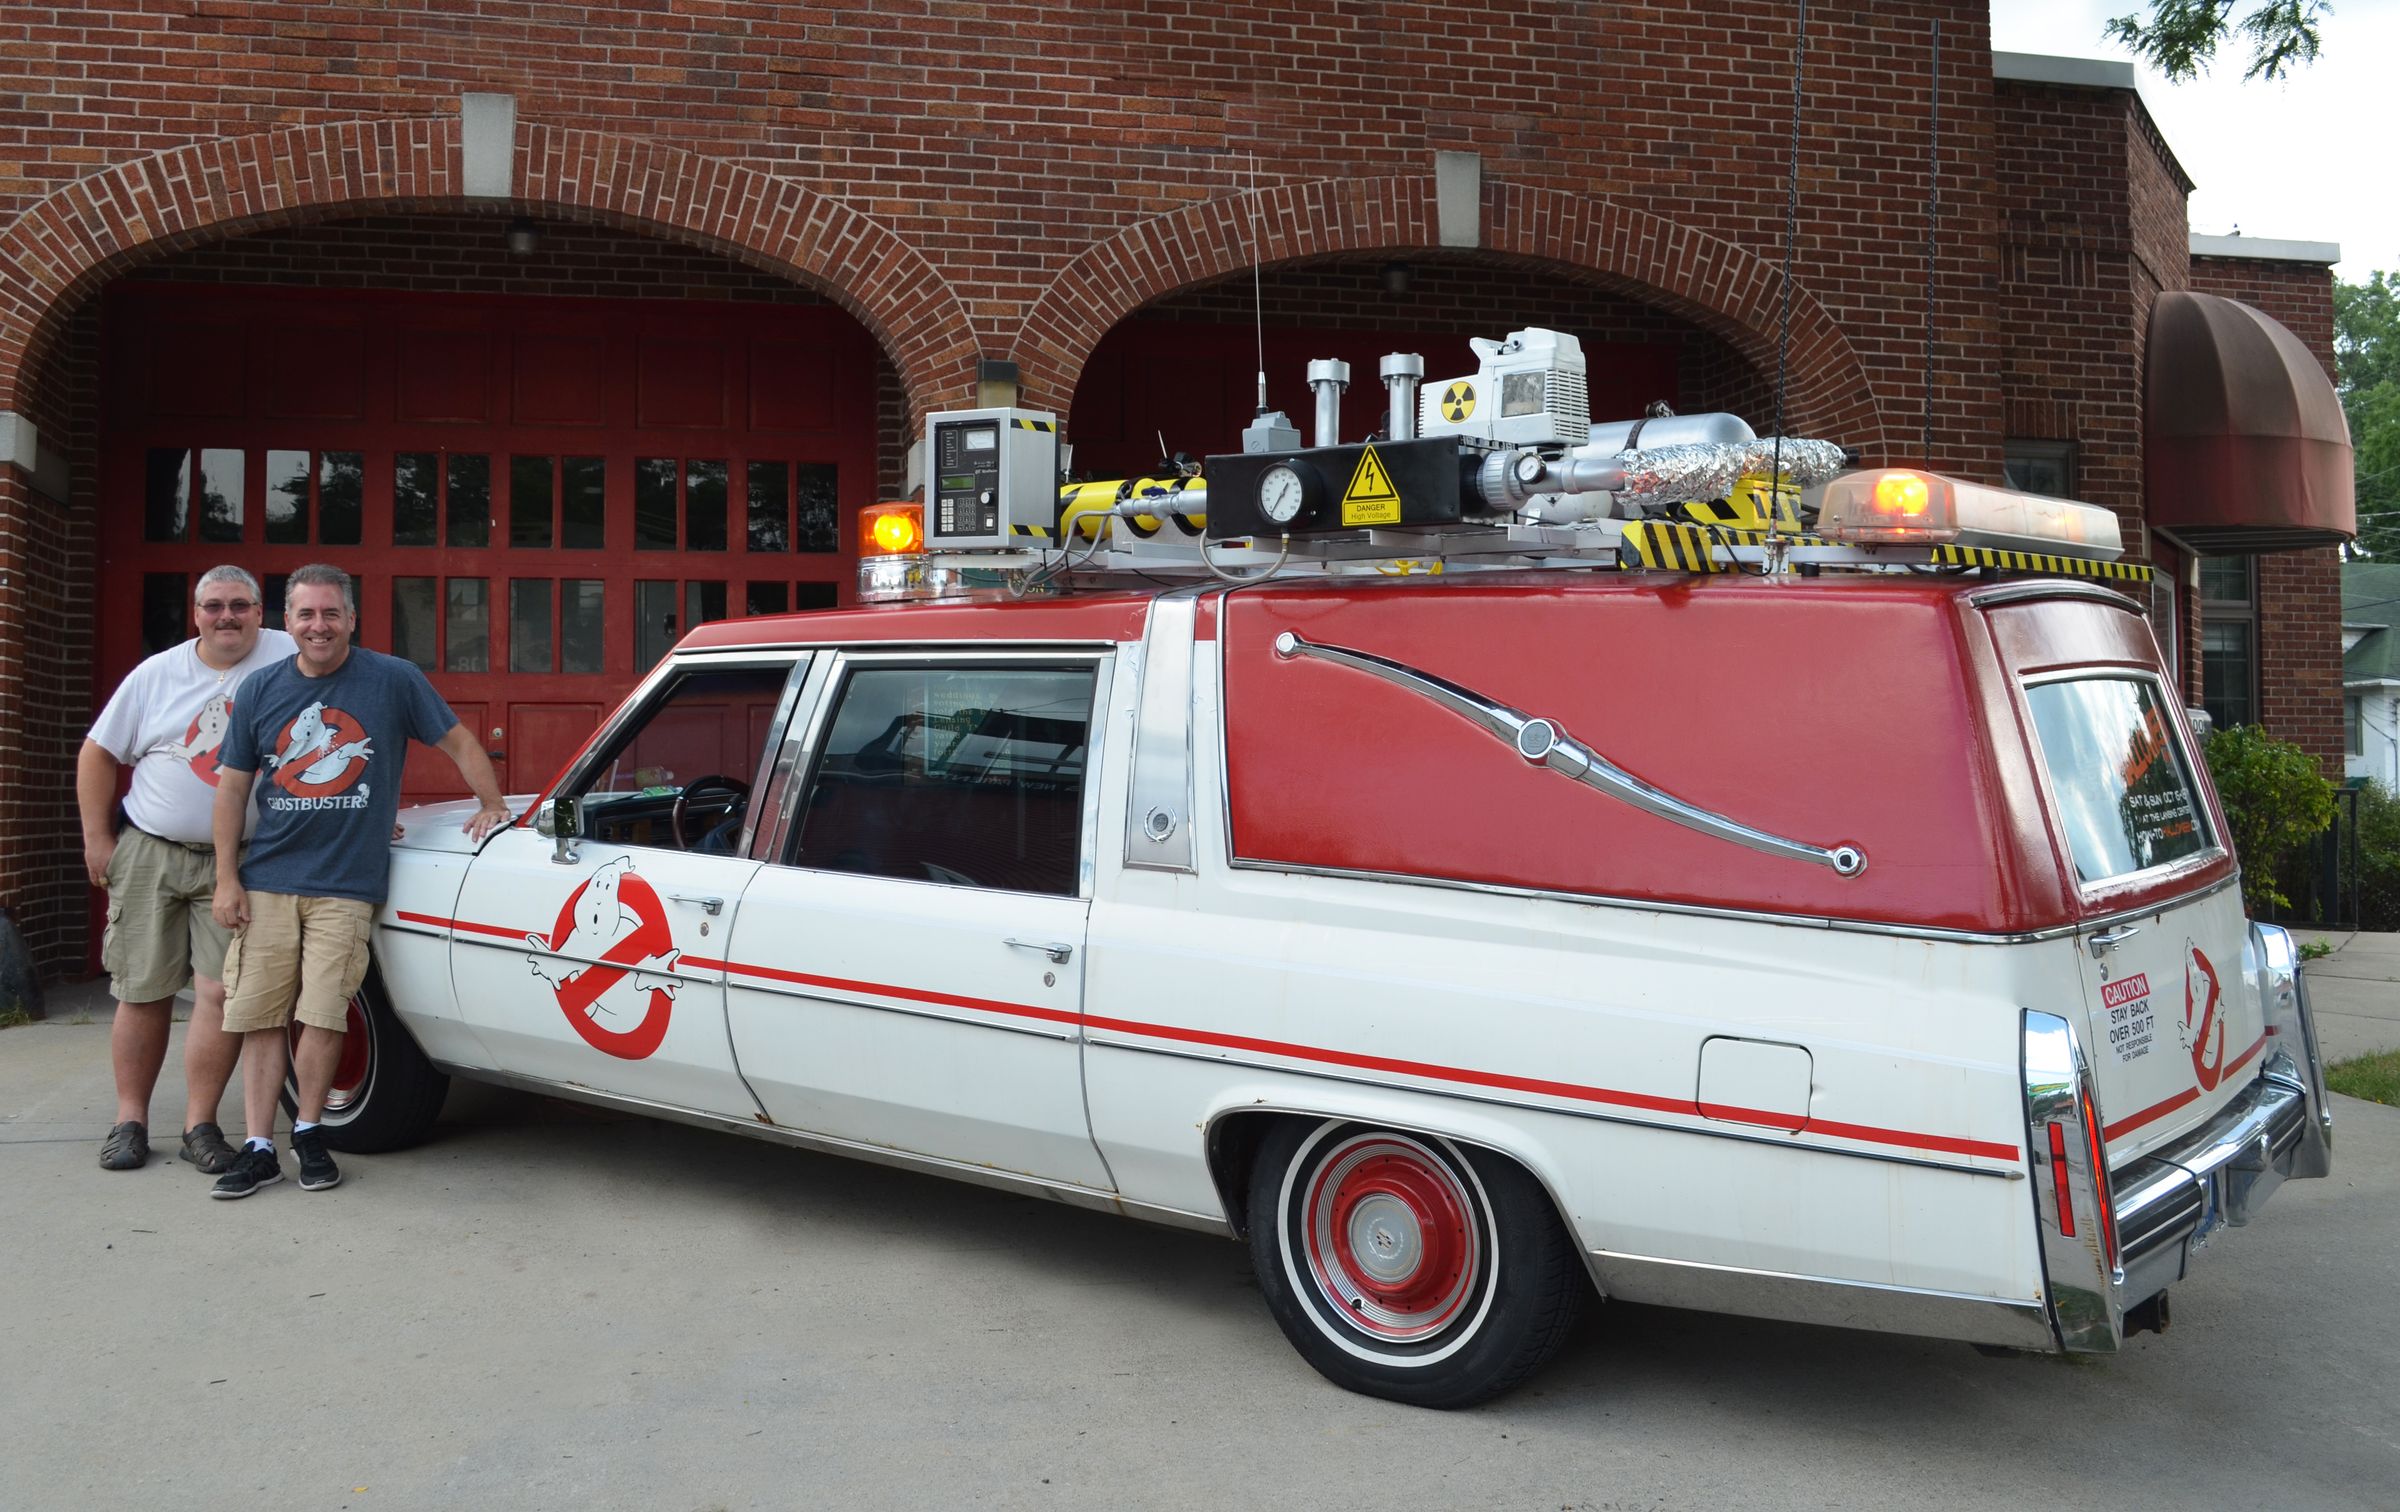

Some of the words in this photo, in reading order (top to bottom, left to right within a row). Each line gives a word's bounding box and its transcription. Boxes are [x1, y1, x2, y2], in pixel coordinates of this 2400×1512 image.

[1351, 511, 1366, 520] High
[1367, 511, 1391, 520] Voltage
[1356, 503, 1386, 512] DANGER
[267, 795, 369, 811] GHOSTBUSTERS
[2129, 794, 2143, 808] SAT
[2163, 791, 2175, 803] OCT
[2104, 976, 2147, 1005] CAUTION
[2110, 1005, 2128, 1024] STAY
[2130, 998, 2149, 1018] BACK
[2109, 1025, 2130, 1044] OVER
[2131, 1019, 2145, 1036] 500
[2146, 1015, 2154, 1030] FT
[2115, 1043, 2125, 1054] NOT
[2126, 1033, 2153, 1051] RESPONSIBLE
[2122, 1052, 2131, 1063] FOR
[2132, 1045, 2149, 1060] DAMAGE
